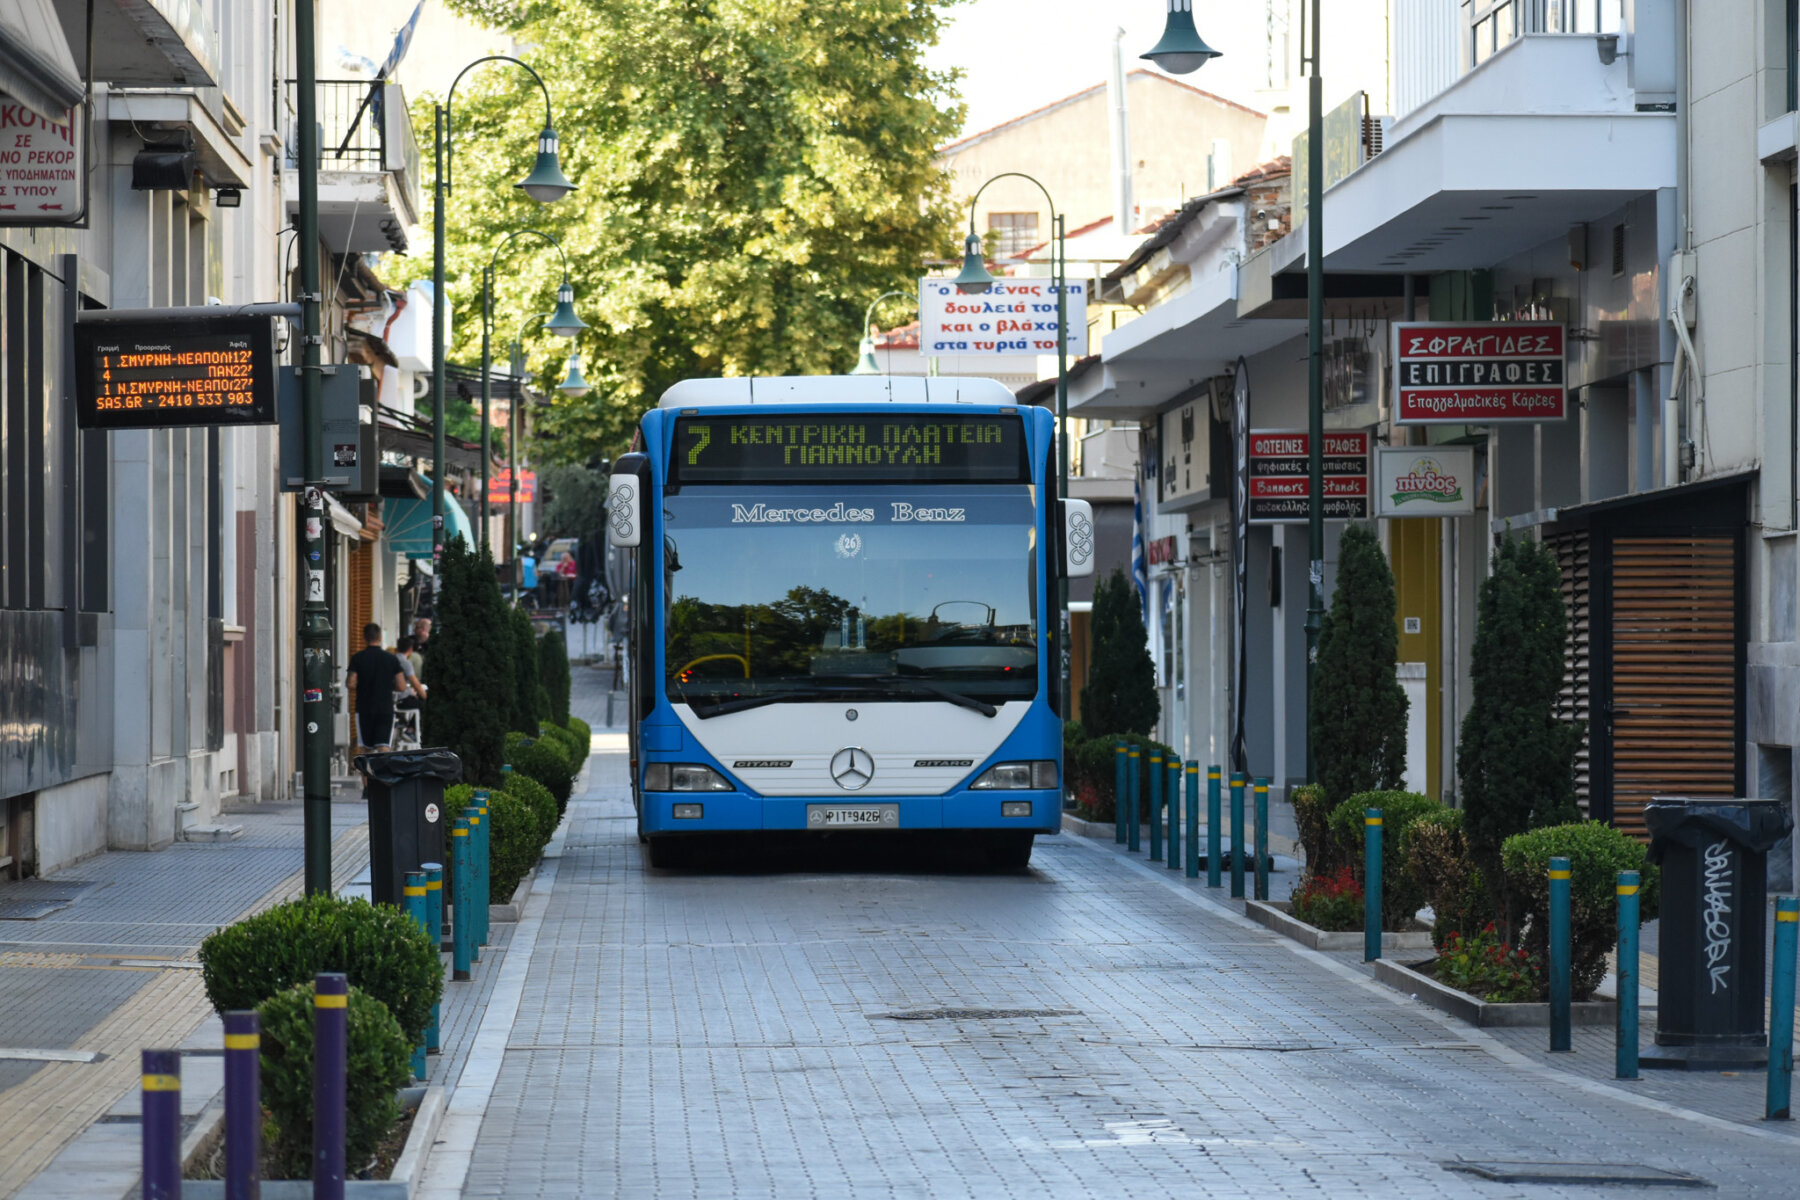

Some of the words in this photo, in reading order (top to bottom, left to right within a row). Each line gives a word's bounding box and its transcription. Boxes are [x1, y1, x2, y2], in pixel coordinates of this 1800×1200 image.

[15, 134, 32, 148] ΣΕ
[28, 151, 75, 164] ΡΕΚΟΡ
[6, 169, 76, 180] ΥΠΟΔΗΜΑΤΩΝ
[13, 186, 57, 196] ΤΥΠΟΥ
[945, 301, 1026, 314] δουλειά
[941, 322, 973, 332] και
[979, 322, 991, 331] ο
[934, 341, 968, 350] στα
[973, 337, 1027, 352] τυριά
[1408, 335, 1554, 355] ΣΦΡΑΓΙΔΕΣ
[103, 355, 110, 368] 1
[102, 369, 111, 382] 4
[1410, 362, 1552, 384] ΕΠΙΓΡΑΦΕΣ
[104, 383, 111, 395] 1
[96, 396, 143, 410] SAS.GR
[158, 394, 193, 407] 2410
[197, 393, 223, 406] 533
[227, 391, 254, 405] 903
[1408, 392, 1507, 412] Επαγγελματικές
[1512, 392, 1556, 411] Κάρτες
[731, 424, 866, 444] ΚΕΝΤΡΙΚΗ
[883, 424, 1001, 443] ΠΛΑΤΕΙΑ
[688, 426, 711, 465] 7
[1255, 439, 1304, 454] ΦΩΤΕΙΝΕΣ
[784, 445, 940, 464] ΓΙΑΝΝΟΥΛΗ
[1257, 460, 1303, 474] ψηφιακές
[1257, 481, 1304, 494] Banners
[1322, 480, 1360, 493] Stands
[1396, 472, 1457, 495] πίνδος
[731, 502, 875, 523] Mercedes
[891, 502, 966, 522] Benz
[844, 537, 857, 549] 26
